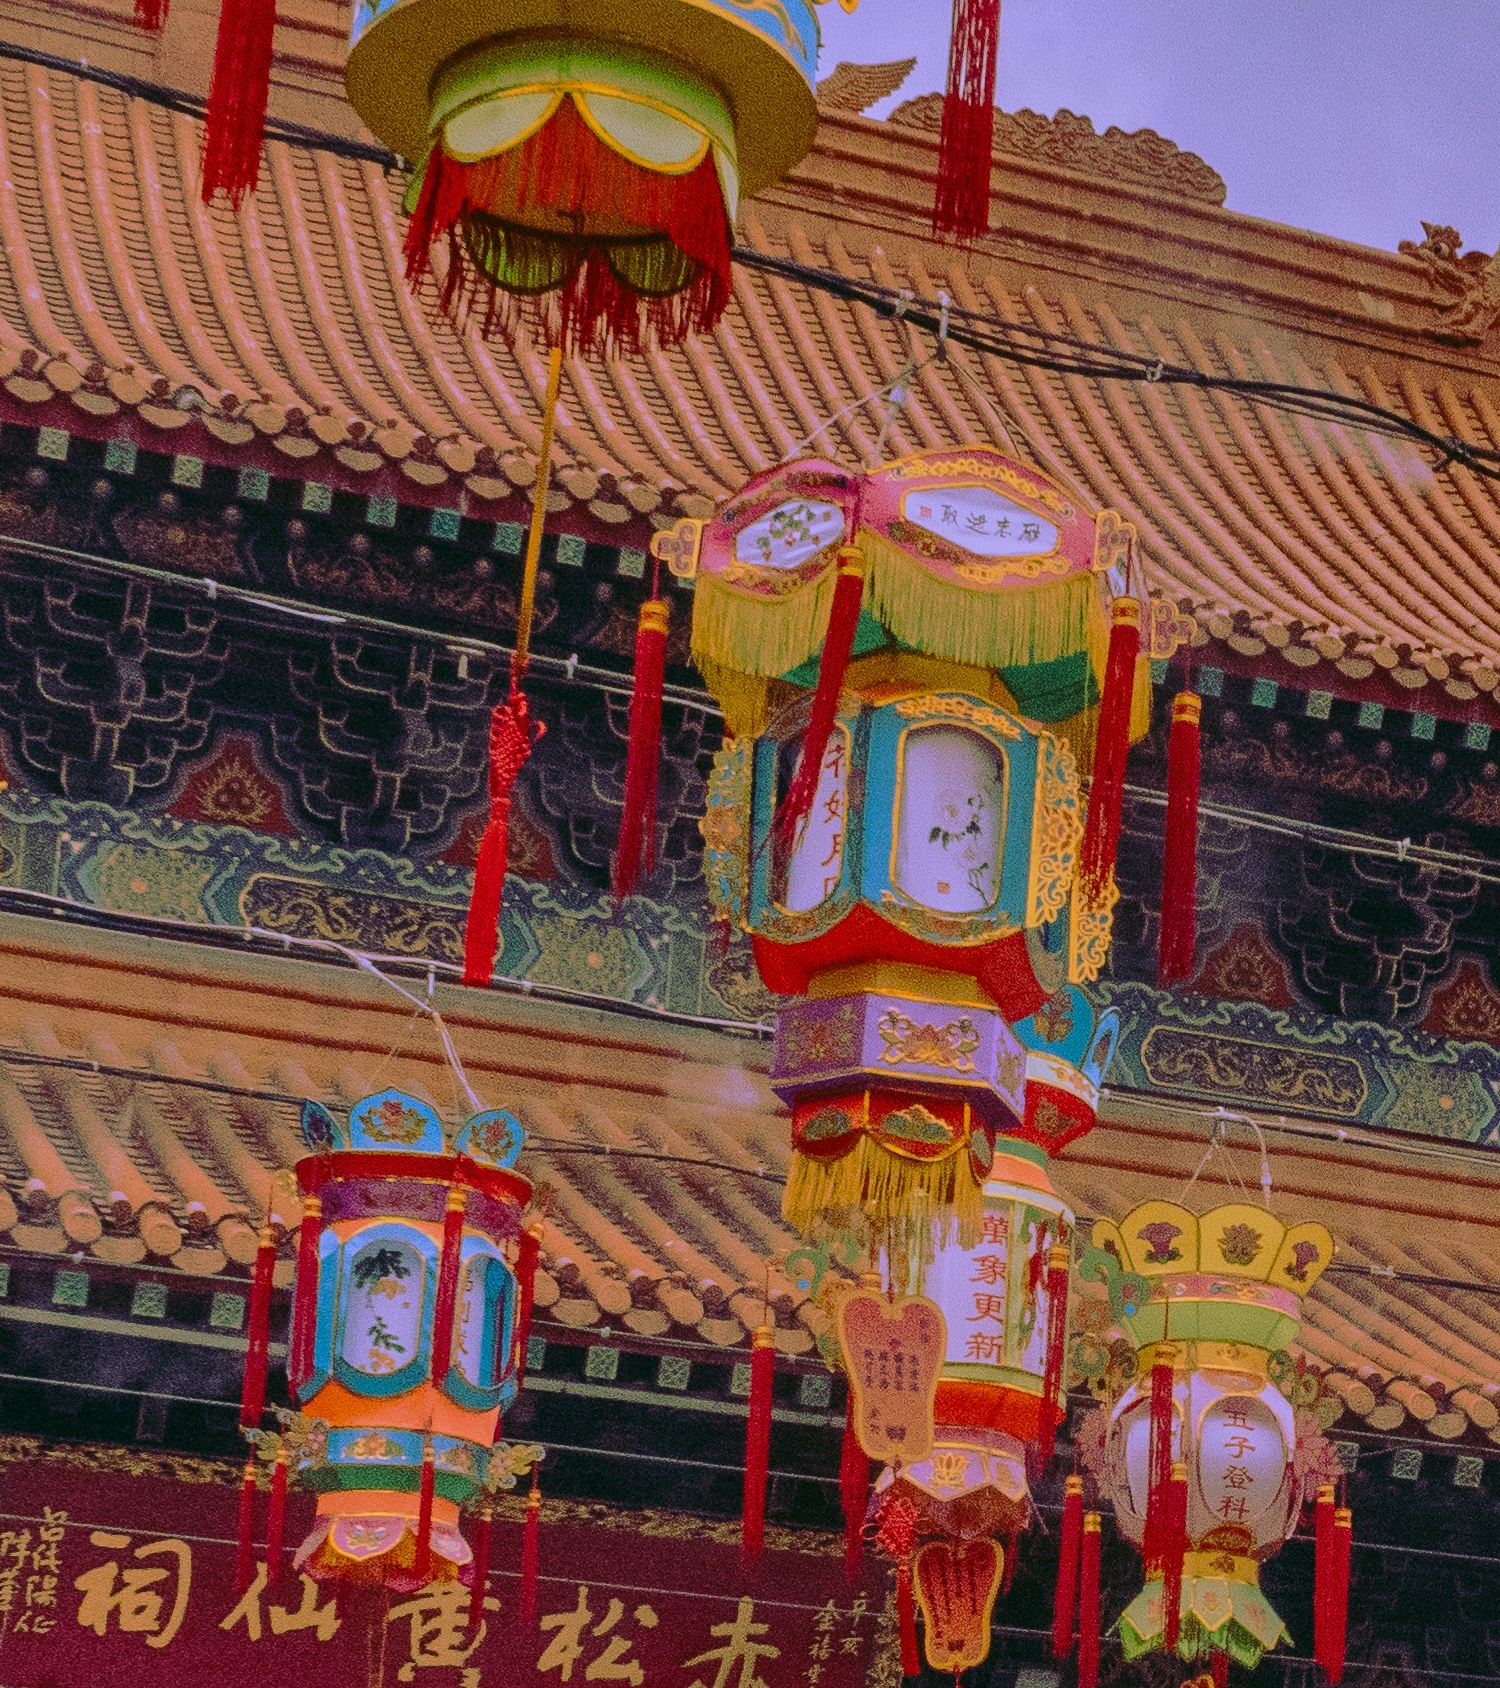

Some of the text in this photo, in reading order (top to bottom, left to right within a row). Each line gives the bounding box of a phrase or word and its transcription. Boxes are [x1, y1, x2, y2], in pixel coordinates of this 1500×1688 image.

[964, 1215, 1009, 1360] 萬象更新
[1216, 1401, 1257, 1520] 五子登科
